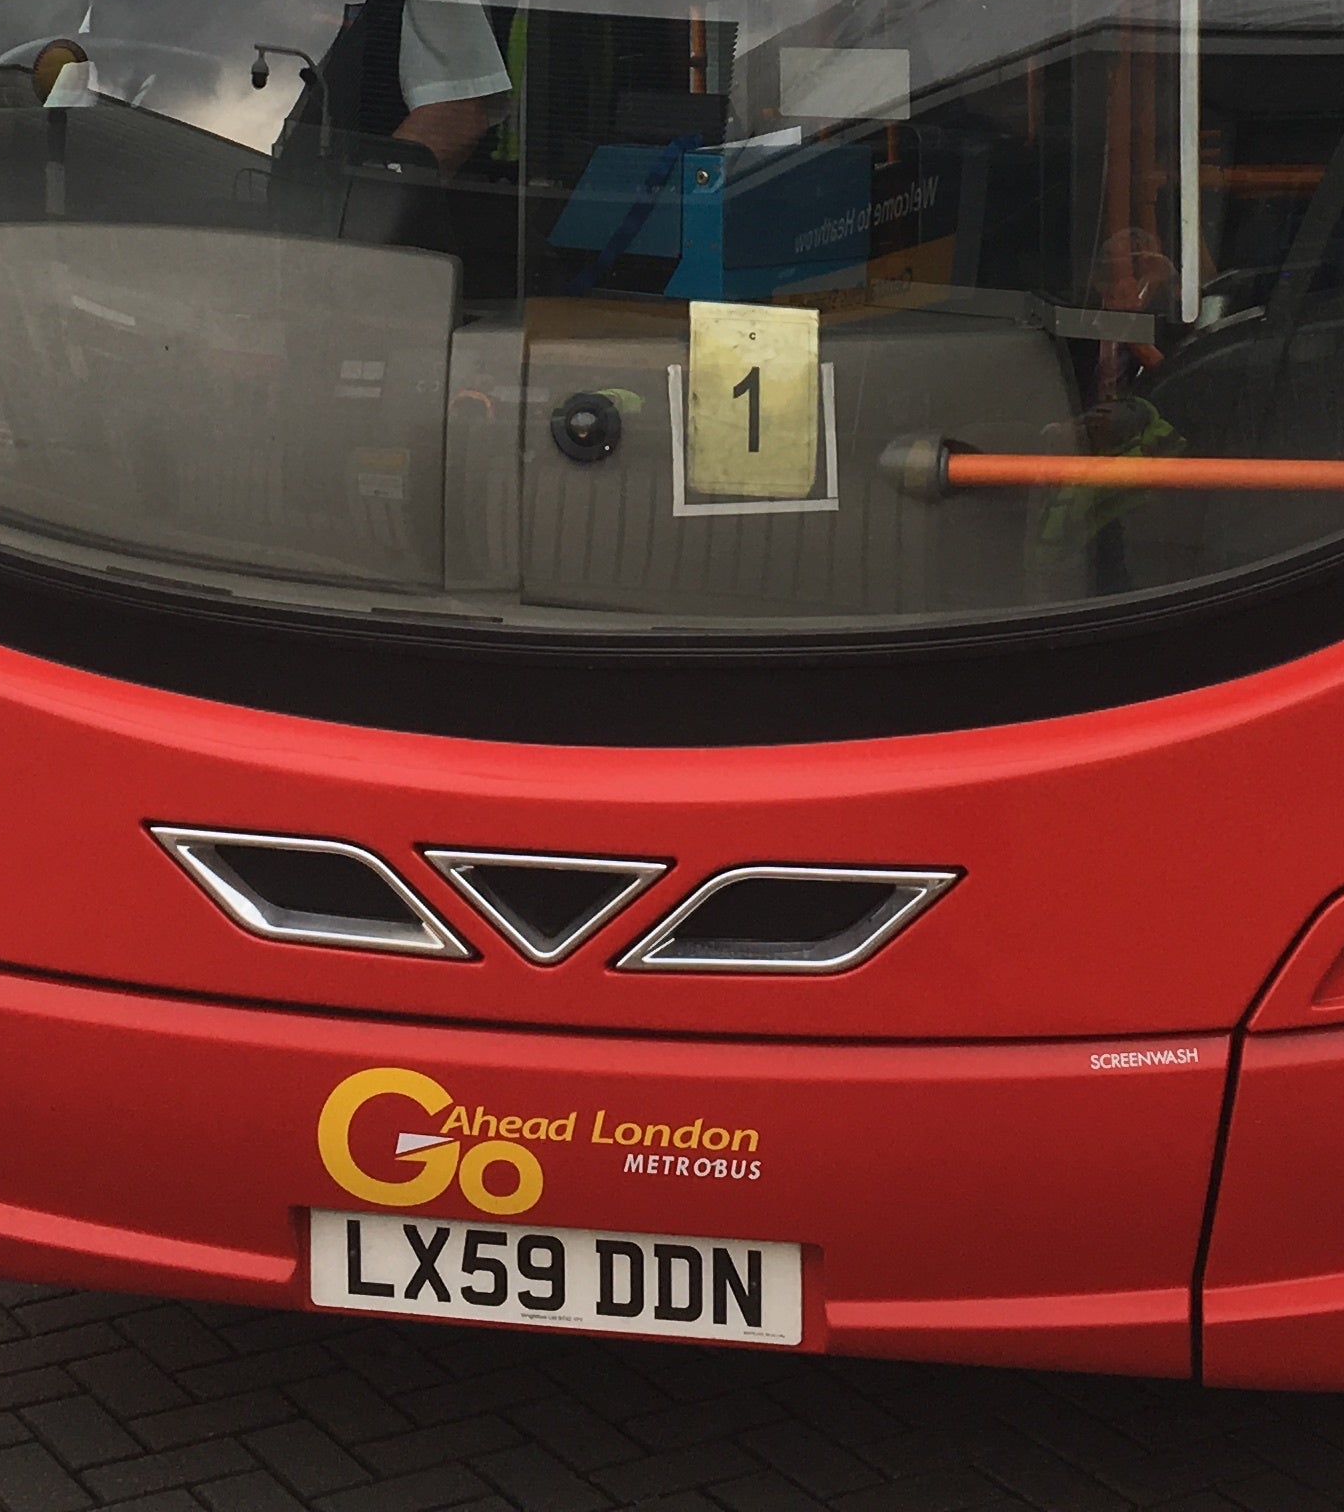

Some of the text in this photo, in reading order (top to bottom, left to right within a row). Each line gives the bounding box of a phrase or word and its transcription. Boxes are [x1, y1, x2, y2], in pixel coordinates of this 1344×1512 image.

[733, 366, 760, 453] 1
[1090, 1047, 1199, 1070] SCREENWASH
[317, 1067, 759, 1215] Go Ahead London
[623, 1153, 762, 1181] METROBUS
[346, 1219, 763, 1328] LX59 DDN
